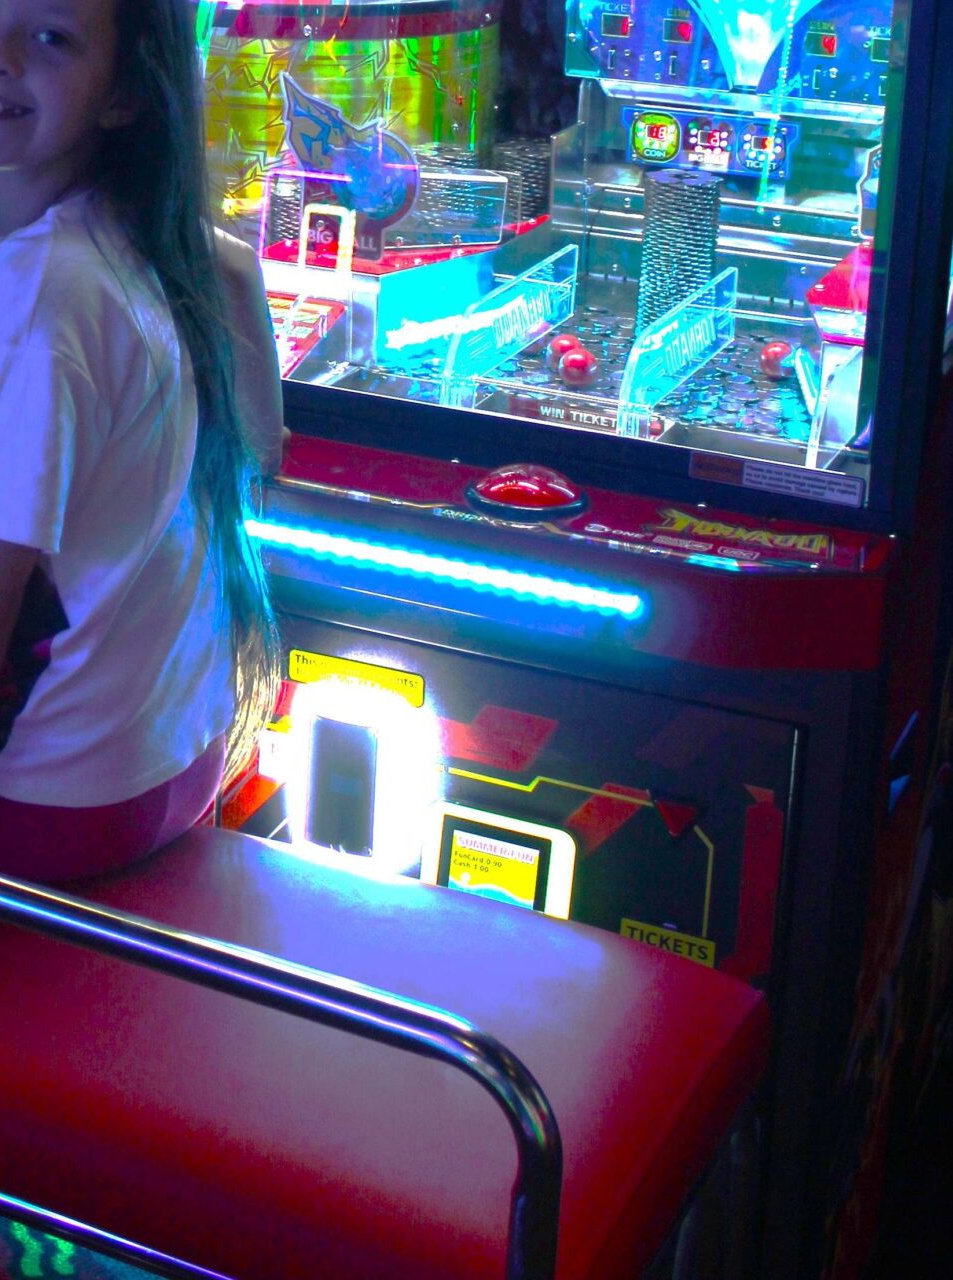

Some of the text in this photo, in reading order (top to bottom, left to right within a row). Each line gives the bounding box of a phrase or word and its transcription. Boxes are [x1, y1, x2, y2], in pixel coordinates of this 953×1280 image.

[644, 149, 666, 158] COIN
[745, 159, 777, 171] TICET
[308, 229, 334, 244] BIG
[540, 405, 565, 420] WIN
[655, 508, 828, 555] TORNADO
[453, 858, 471, 869] Cash
[454, 850, 484, 864] FunCard
[626, 924, 709, 961] TICKETS
